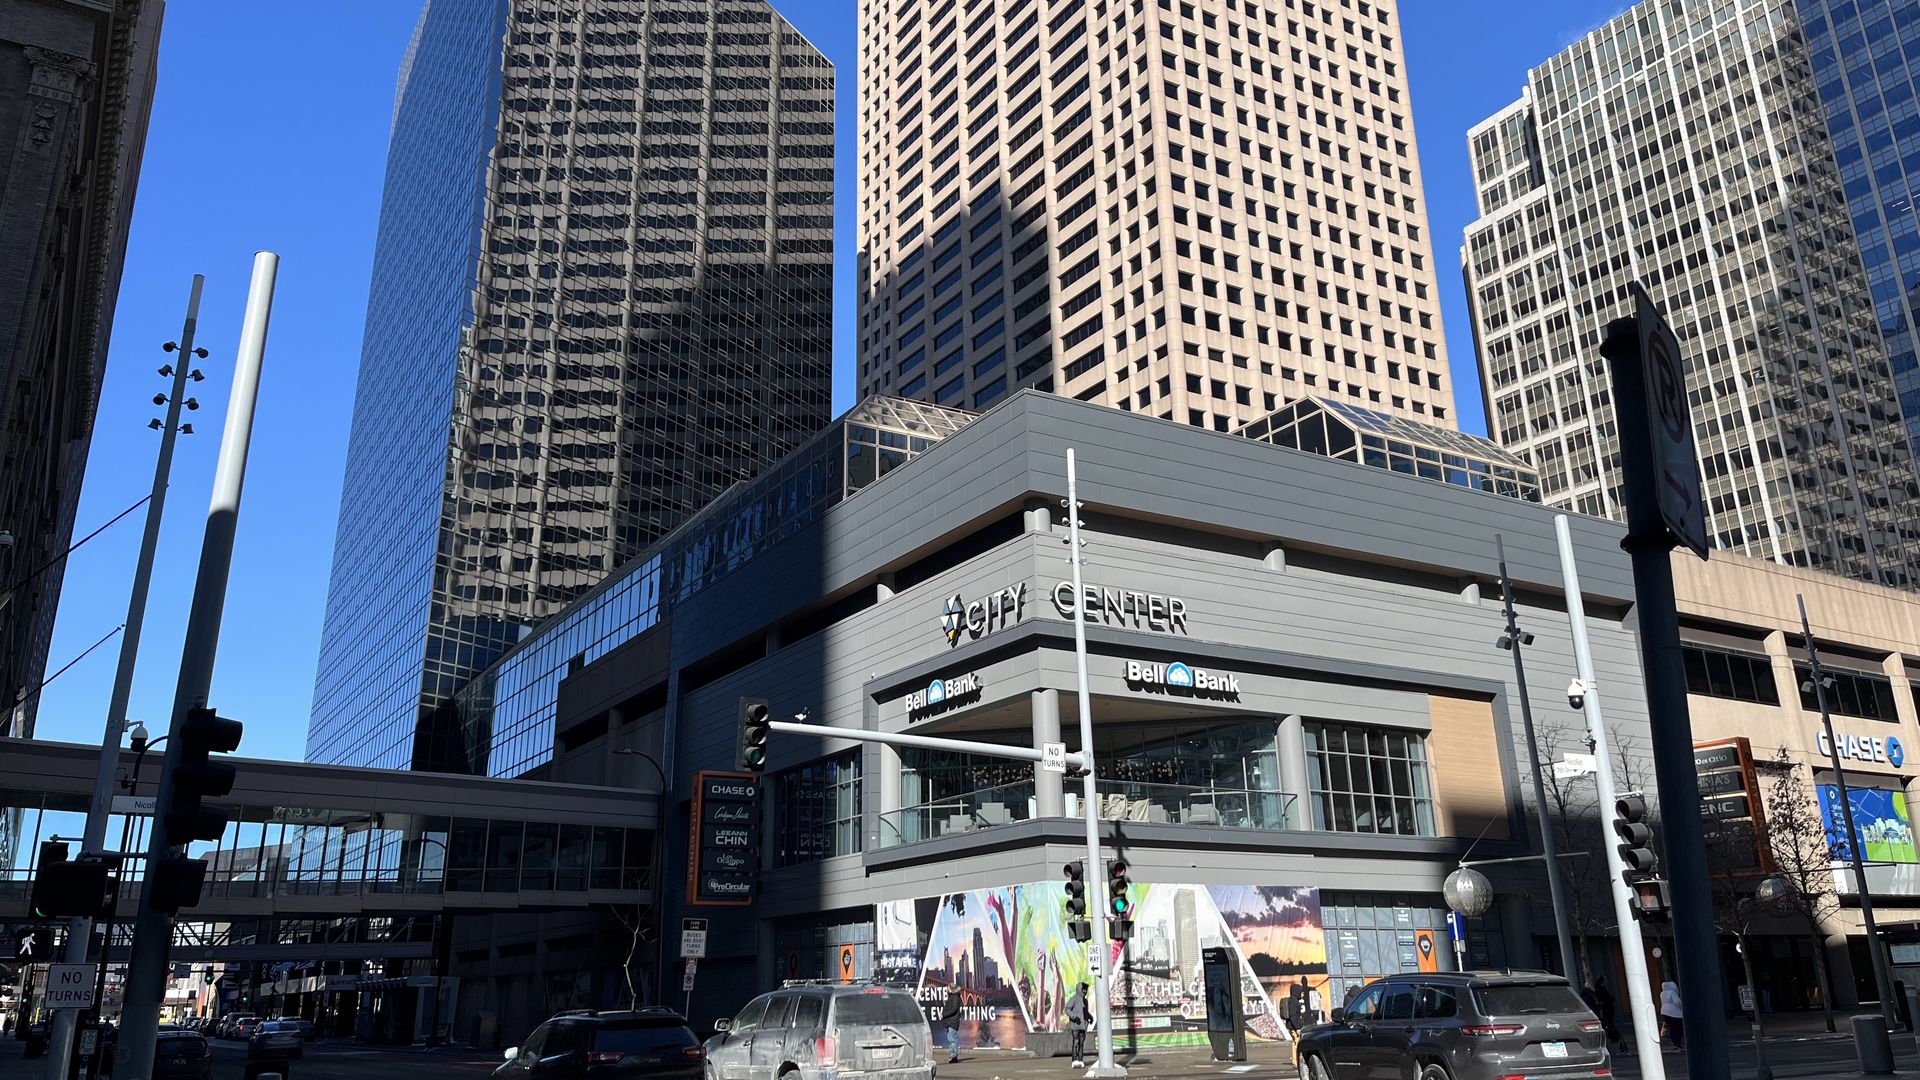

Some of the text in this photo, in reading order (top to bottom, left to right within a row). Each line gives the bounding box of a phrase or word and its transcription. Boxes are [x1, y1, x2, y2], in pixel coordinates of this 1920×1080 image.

[965, 580, 1187, 632] CITY CENTER
[1127, 661, 1240, 693] Bell Bank
[905, 673, 977, 713] Bell Bank
[1048, 747, 1060, 757] NO
[1816, 731, 1887, 763] CHASE
[1043, 759, 1066, 769] TURNS
[711, 785, 745, 795] CHASE
[134, 801, 155, 809] Nicoll
[715, 836, 748, 846] CHIN
[716, 856, 745, 866] Ocampo
[713, 881, 751, 891] ProCircular
[1088, 947, 1099, 955] ONE
[61, 971, 82, 984] NO
[919, 986, 949, 1002] CENTE
[1131, 982, 1147, 997] AT
[1152, 981, 1182, 997] THE
[47, 990, 91, 1001] TURNS
[931, 1006, 996, 1021] EVTHING
